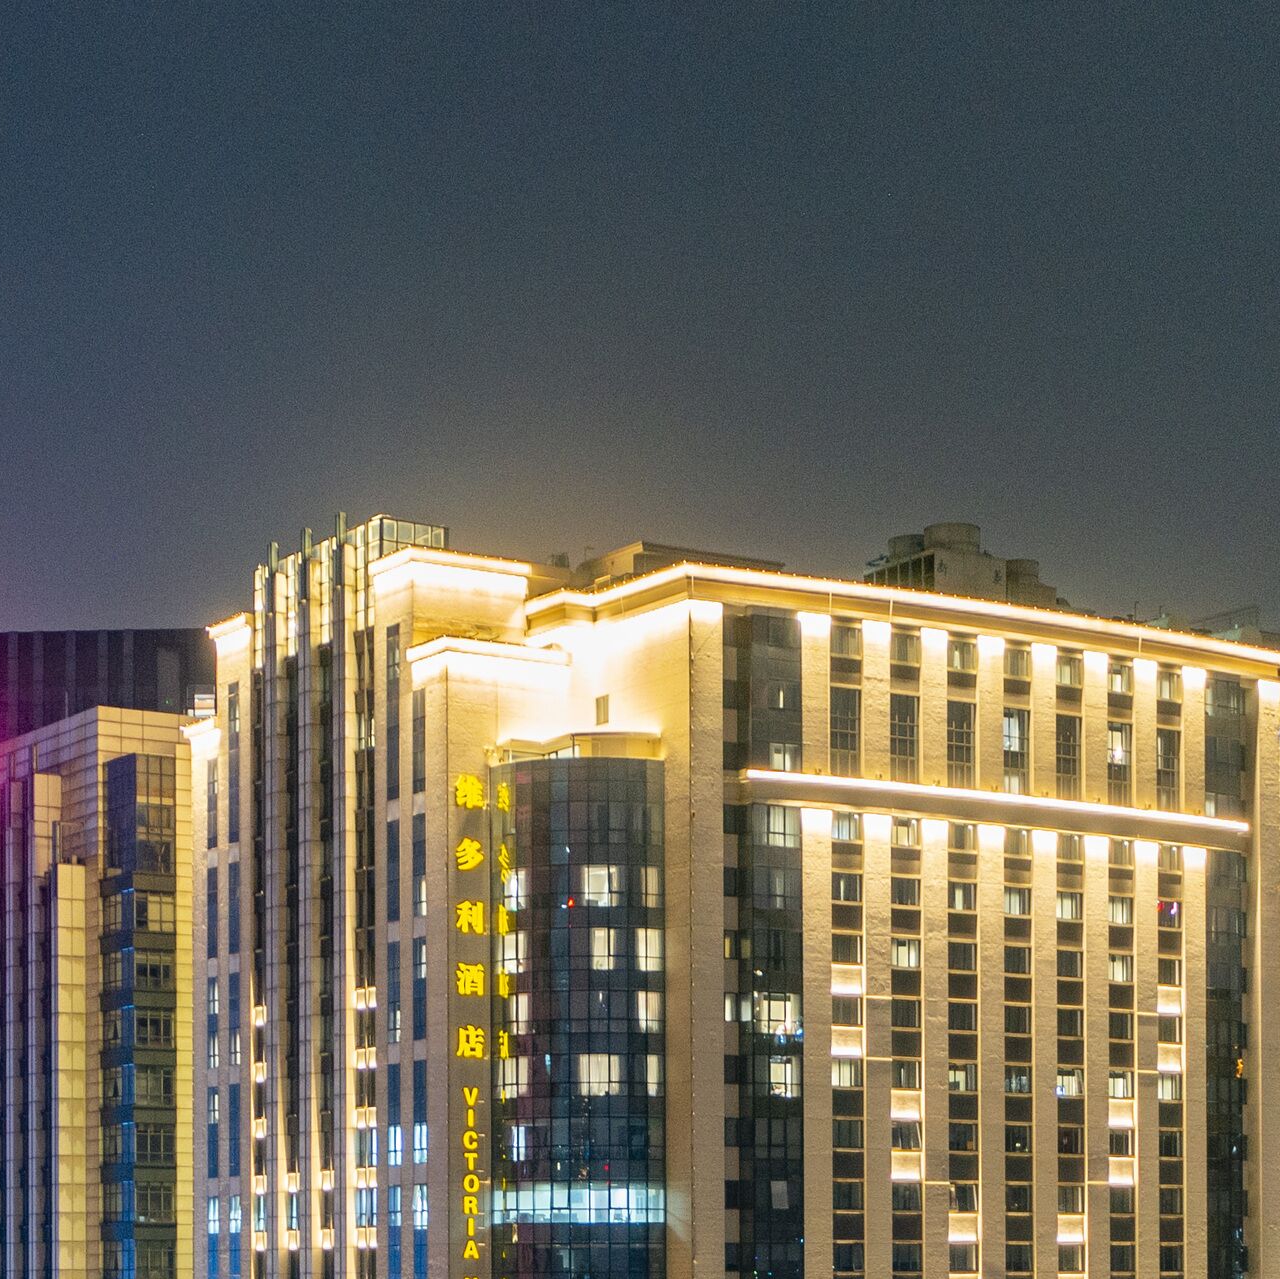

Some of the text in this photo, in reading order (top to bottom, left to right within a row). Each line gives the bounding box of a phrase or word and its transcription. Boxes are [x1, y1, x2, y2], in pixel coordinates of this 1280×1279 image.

[455, 774, 485, 1059] 维多利酒店
[462, 1086, 481, 1260] VICTORIA
